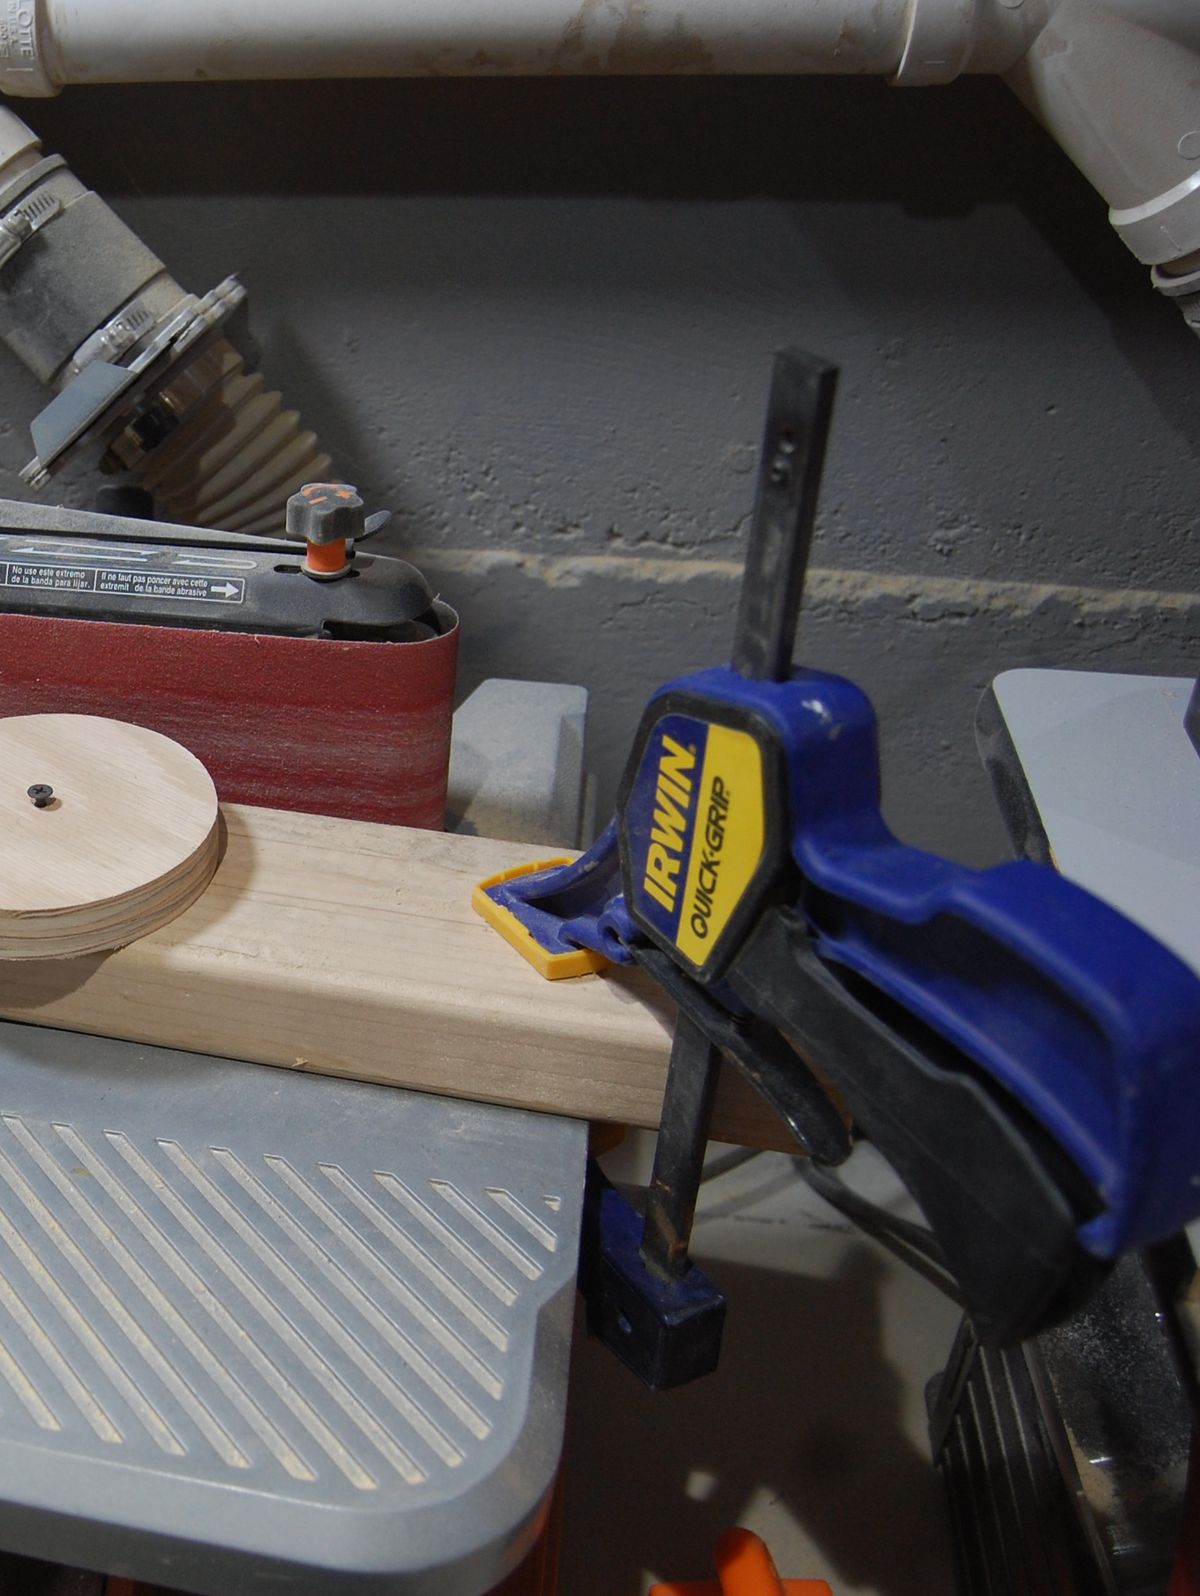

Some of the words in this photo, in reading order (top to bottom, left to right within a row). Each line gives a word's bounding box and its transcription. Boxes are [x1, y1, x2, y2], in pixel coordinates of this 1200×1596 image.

[12, 566, 22, 575] No
[24, 568, 37, 576] use
[39, 568, 54, 578] este
[56, 570, 86, 579] extremo
[11, 576, 20, 584] de
[22, 576, 29, 584] la
[31, 577, 53, 586] banda
[54, 580, 72, 588] para
[73, 580, 90, 590] lijar.
[118, 573, 132, 582] faut
[133, 576, 146, 584] pas
[147, 576, 172, 586] poncer
[172, 578, 192, 586] avec
[134, 584, 144, 592] de
[145, 584, 152, 592] la
[153, 585, 176, 595] bande
[176, 586, 208, 597] abrasive
[643, 734, 697, 913] IRWIN
